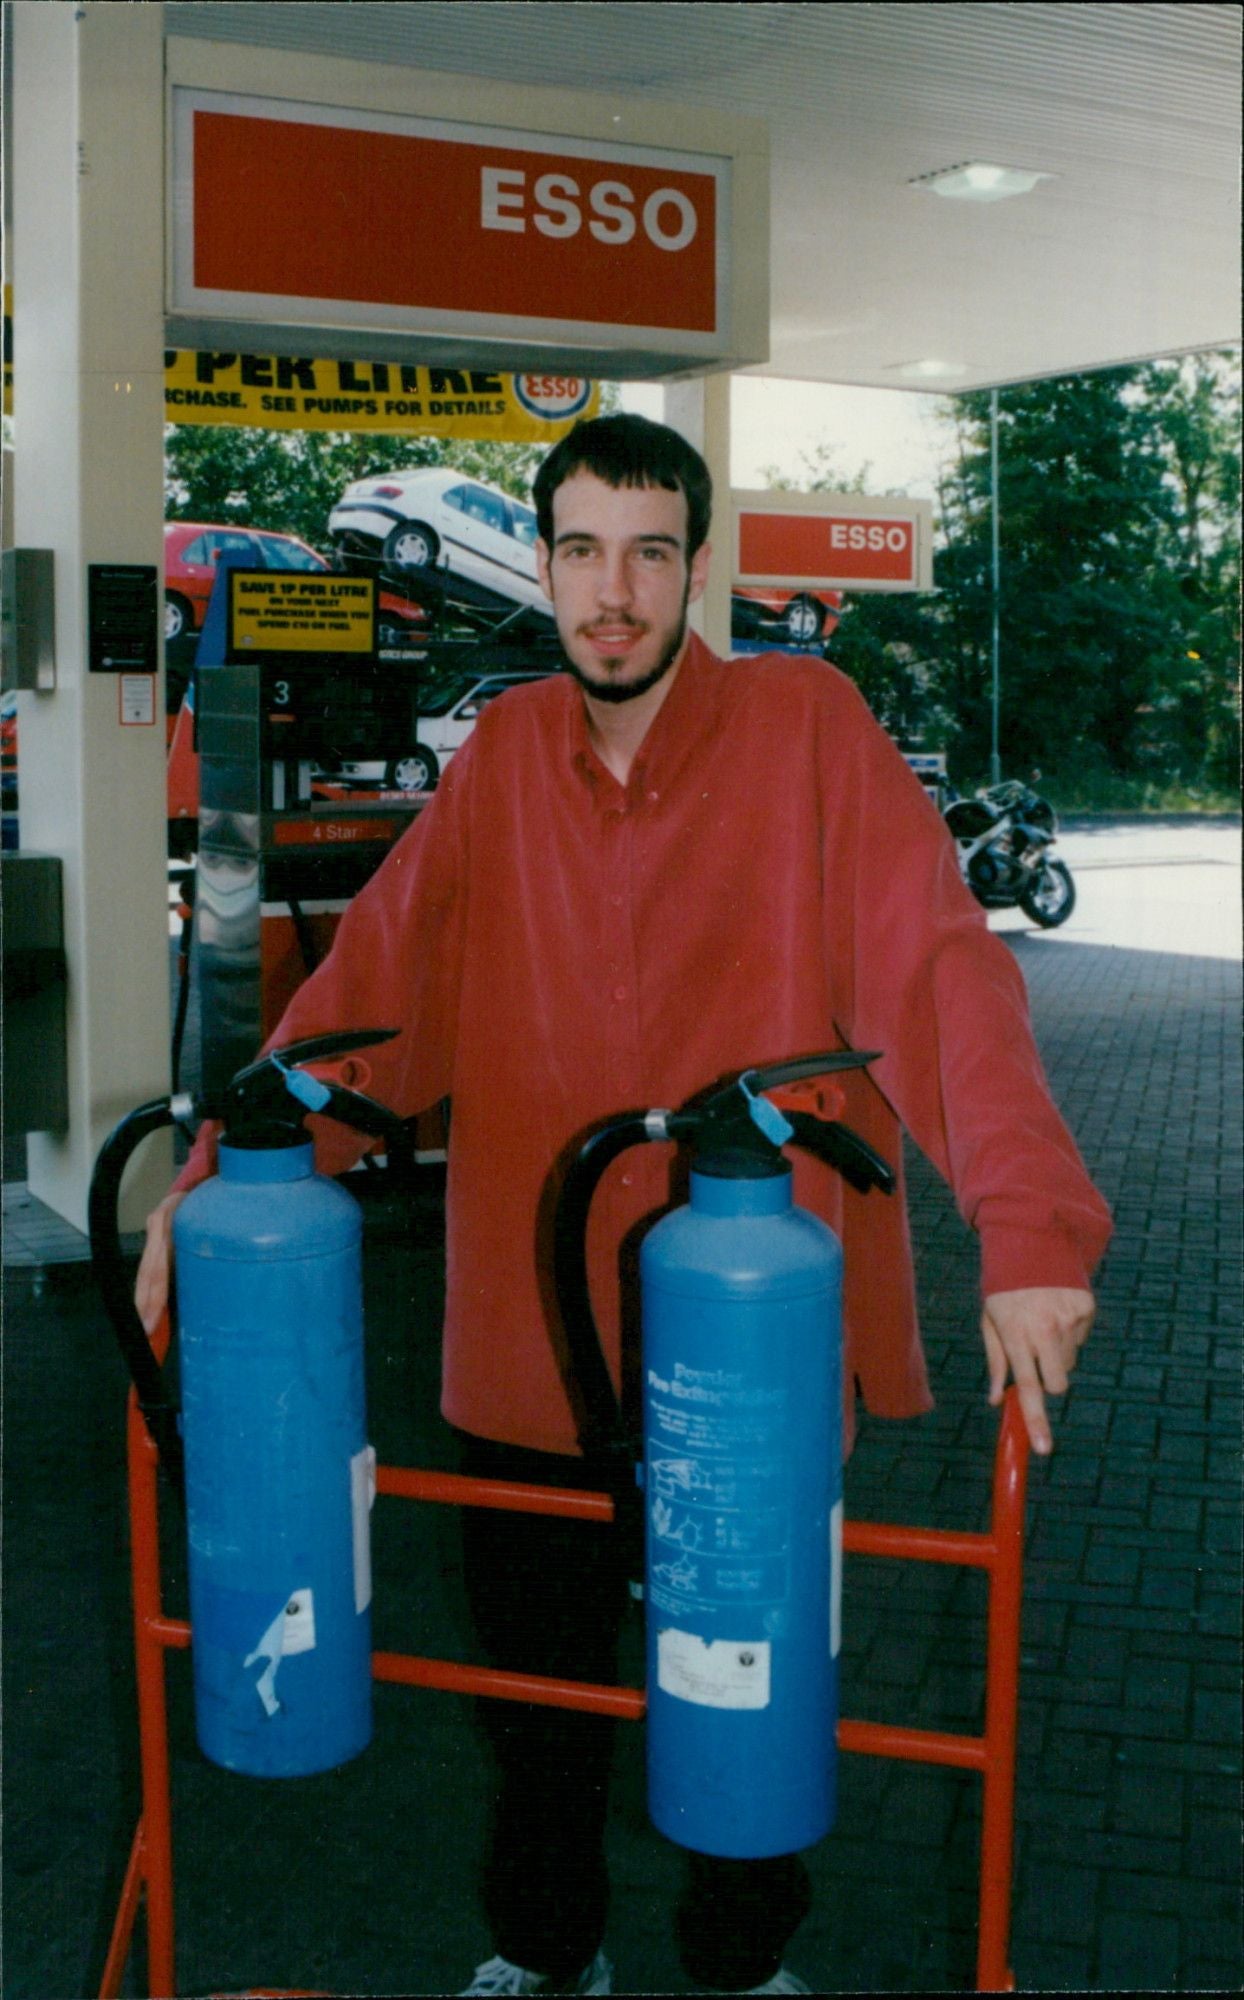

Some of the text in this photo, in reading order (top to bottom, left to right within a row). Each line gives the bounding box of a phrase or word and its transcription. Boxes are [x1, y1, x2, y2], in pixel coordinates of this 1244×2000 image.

[481, 166, 697, 251] ESSO
[196, 351, 316, 390] PER
[261, 394, 296, 412] SEE
[303, 397, 378, 416] PUMPS
[384, 400, 422, 416] FOR
[428, 400, 506, 416] DETAILS
[831, 524, 907, 552] ESSO
[240, 582, 275, 594] SAVE
[299, 584, 326, 596] PER
[330, 585, 368, 598] LITRE
[274, 680, 290, 704] 3
[312, 824, 358, 840] 4 Star
